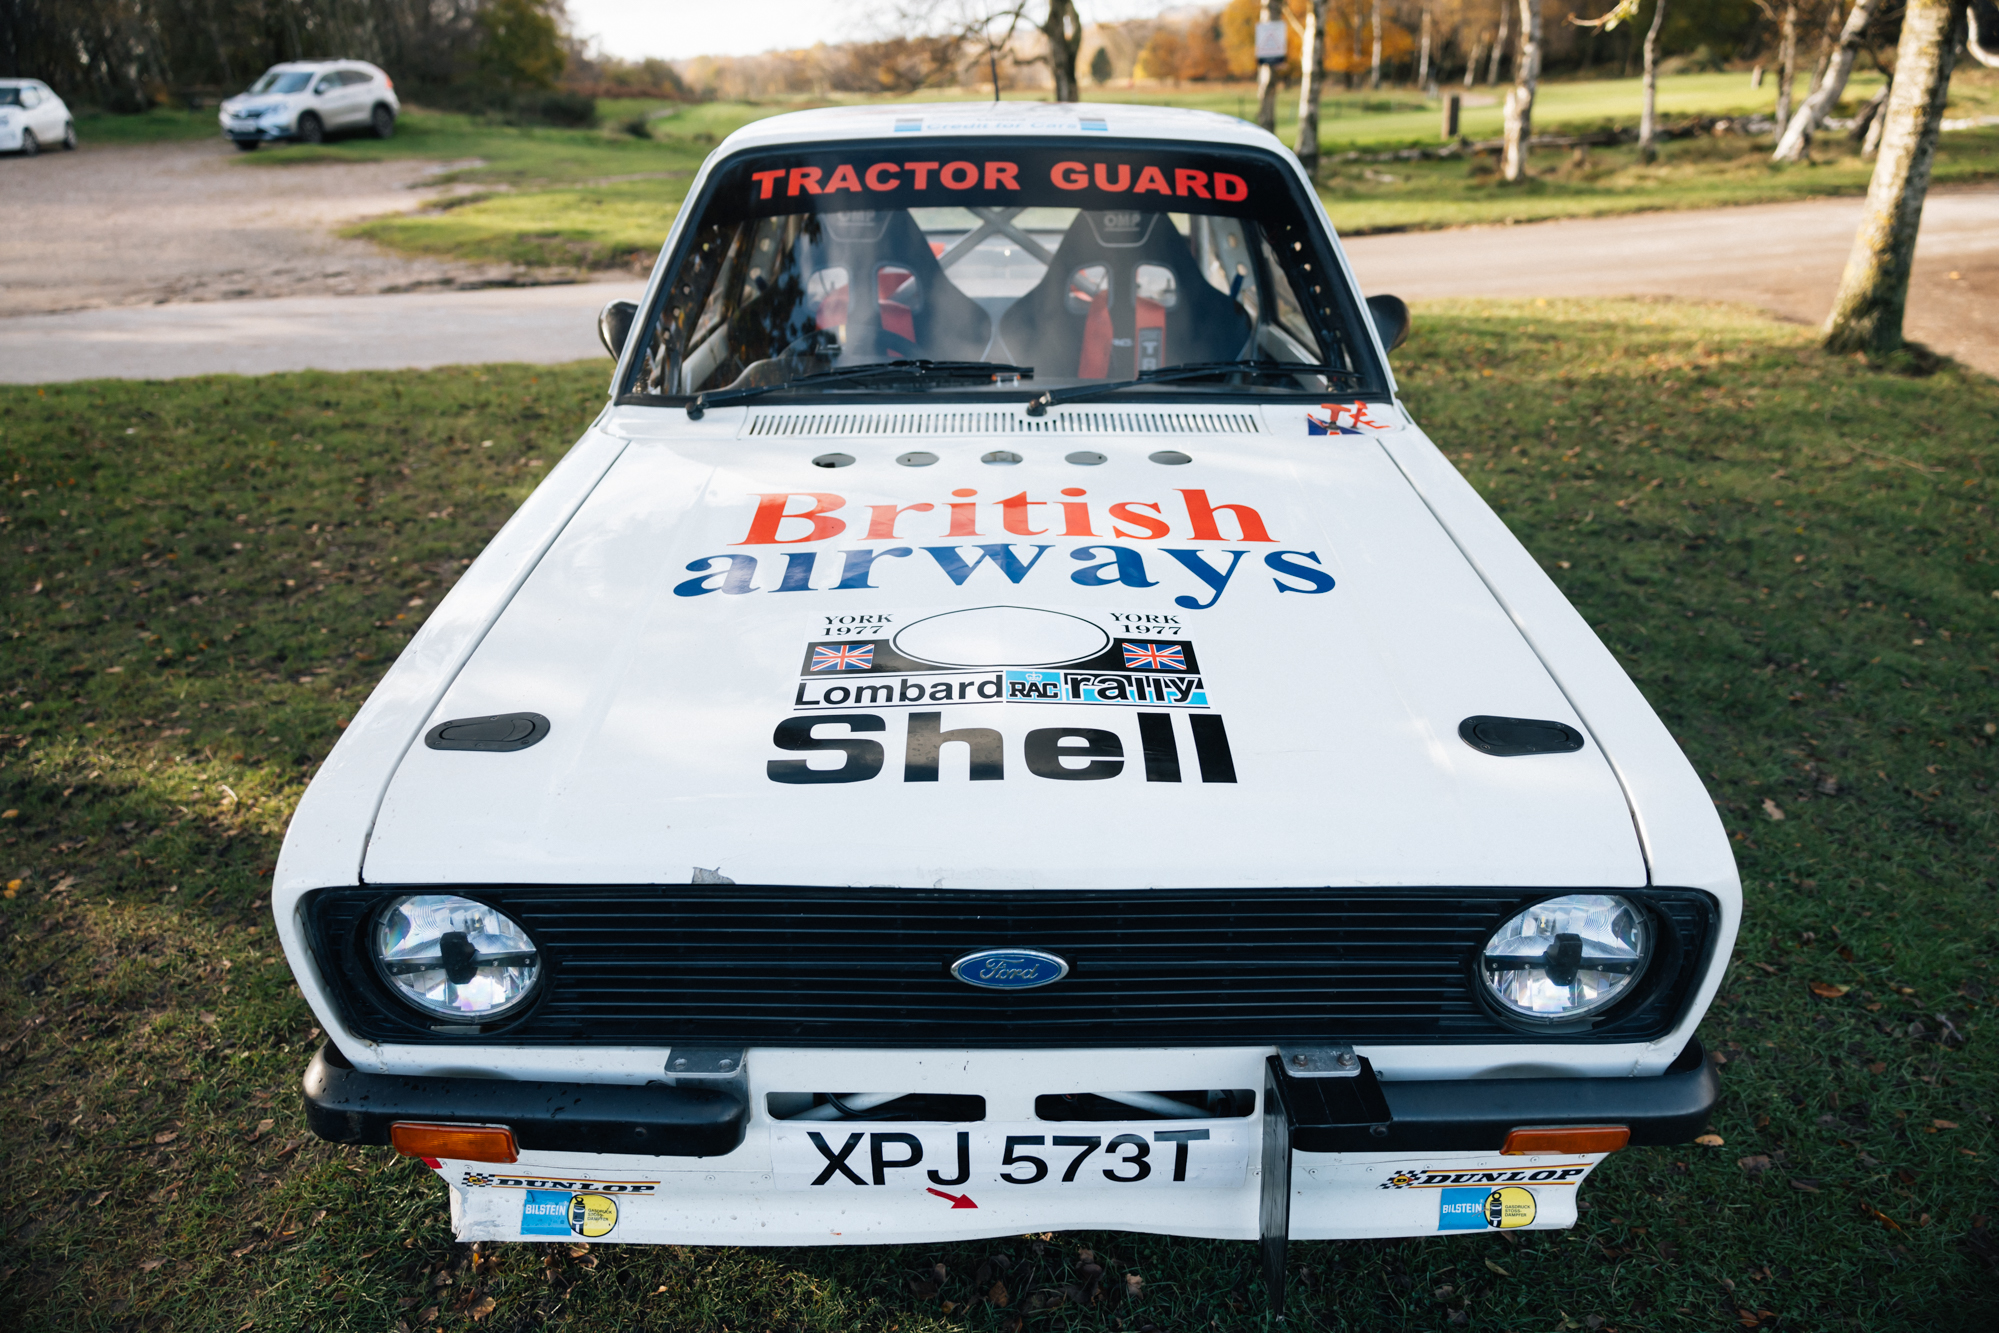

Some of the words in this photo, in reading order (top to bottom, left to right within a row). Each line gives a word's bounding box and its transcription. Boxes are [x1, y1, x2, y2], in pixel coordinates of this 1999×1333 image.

[926, 122, 988, 131] Credit
[995, 121, 1021, 130] for
[1030, 121, 1078, 130] Cars
[752, 161, 1021, 200] TRACTOR
[1050, 161, 1249, 202] GUARD
[726, 487, 1281, 545] British
[673, 542, 1336, 610] airways
[823, 613, 894, 625] YORK
[1109, 612, 1181, 624] YORK
[821, 625, 884, 637] 1977
[1120, 624, 1183, 635] 1977
[794, 674, 1004, 706] Lombard
[1009, 681, 1060, 699] RAC
[1067, 675, 1199, 704] rally
[766, 711, 1238, 784] Shell
[980, 958, 1040, 979] Ford
[805, 1131, 971, 1186] XPJ
[1000, 1129, 1211, 1184] 573T
[1418, 1168, 1585, 1185] DUNLOP
[498, 1178, 655, 1193] DUNLOP
[525, 1204, 567, 1216] BILSTEIN
[1443, 1203, 1482, 1214] BILSTEIN
